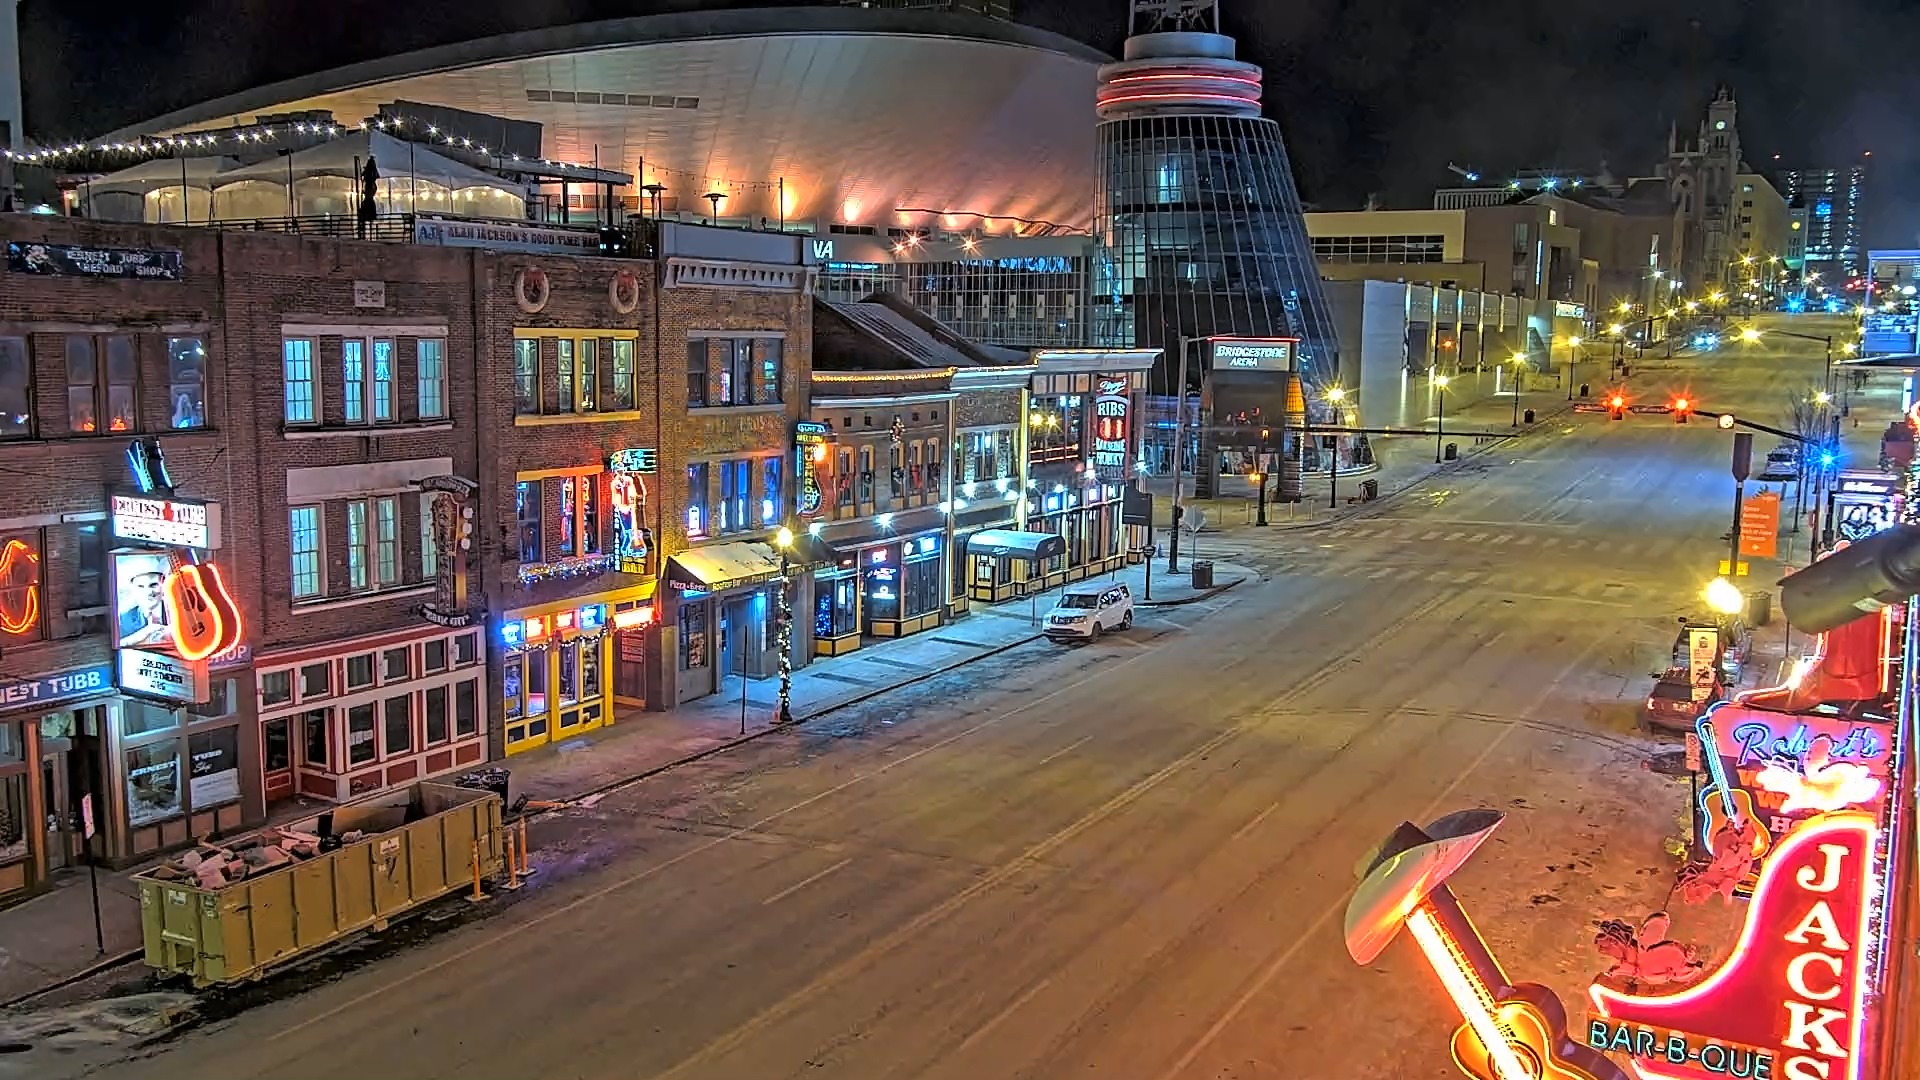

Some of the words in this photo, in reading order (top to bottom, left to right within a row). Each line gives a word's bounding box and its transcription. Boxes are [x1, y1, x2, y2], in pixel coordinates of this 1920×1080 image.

[813, 239, 833, 259] VA
[1216, 345, 1287, 358] BRIDGESTONE
[1229, 357, 1258, 367] ARENA
[1098, 402, 1125, 416] RIBS
[804, 444, 814, 509] MUSHROOM
[48, 671, 100, 694] TUBB
[1590, 1020, 1773, 1080] BAR-B-QUE
